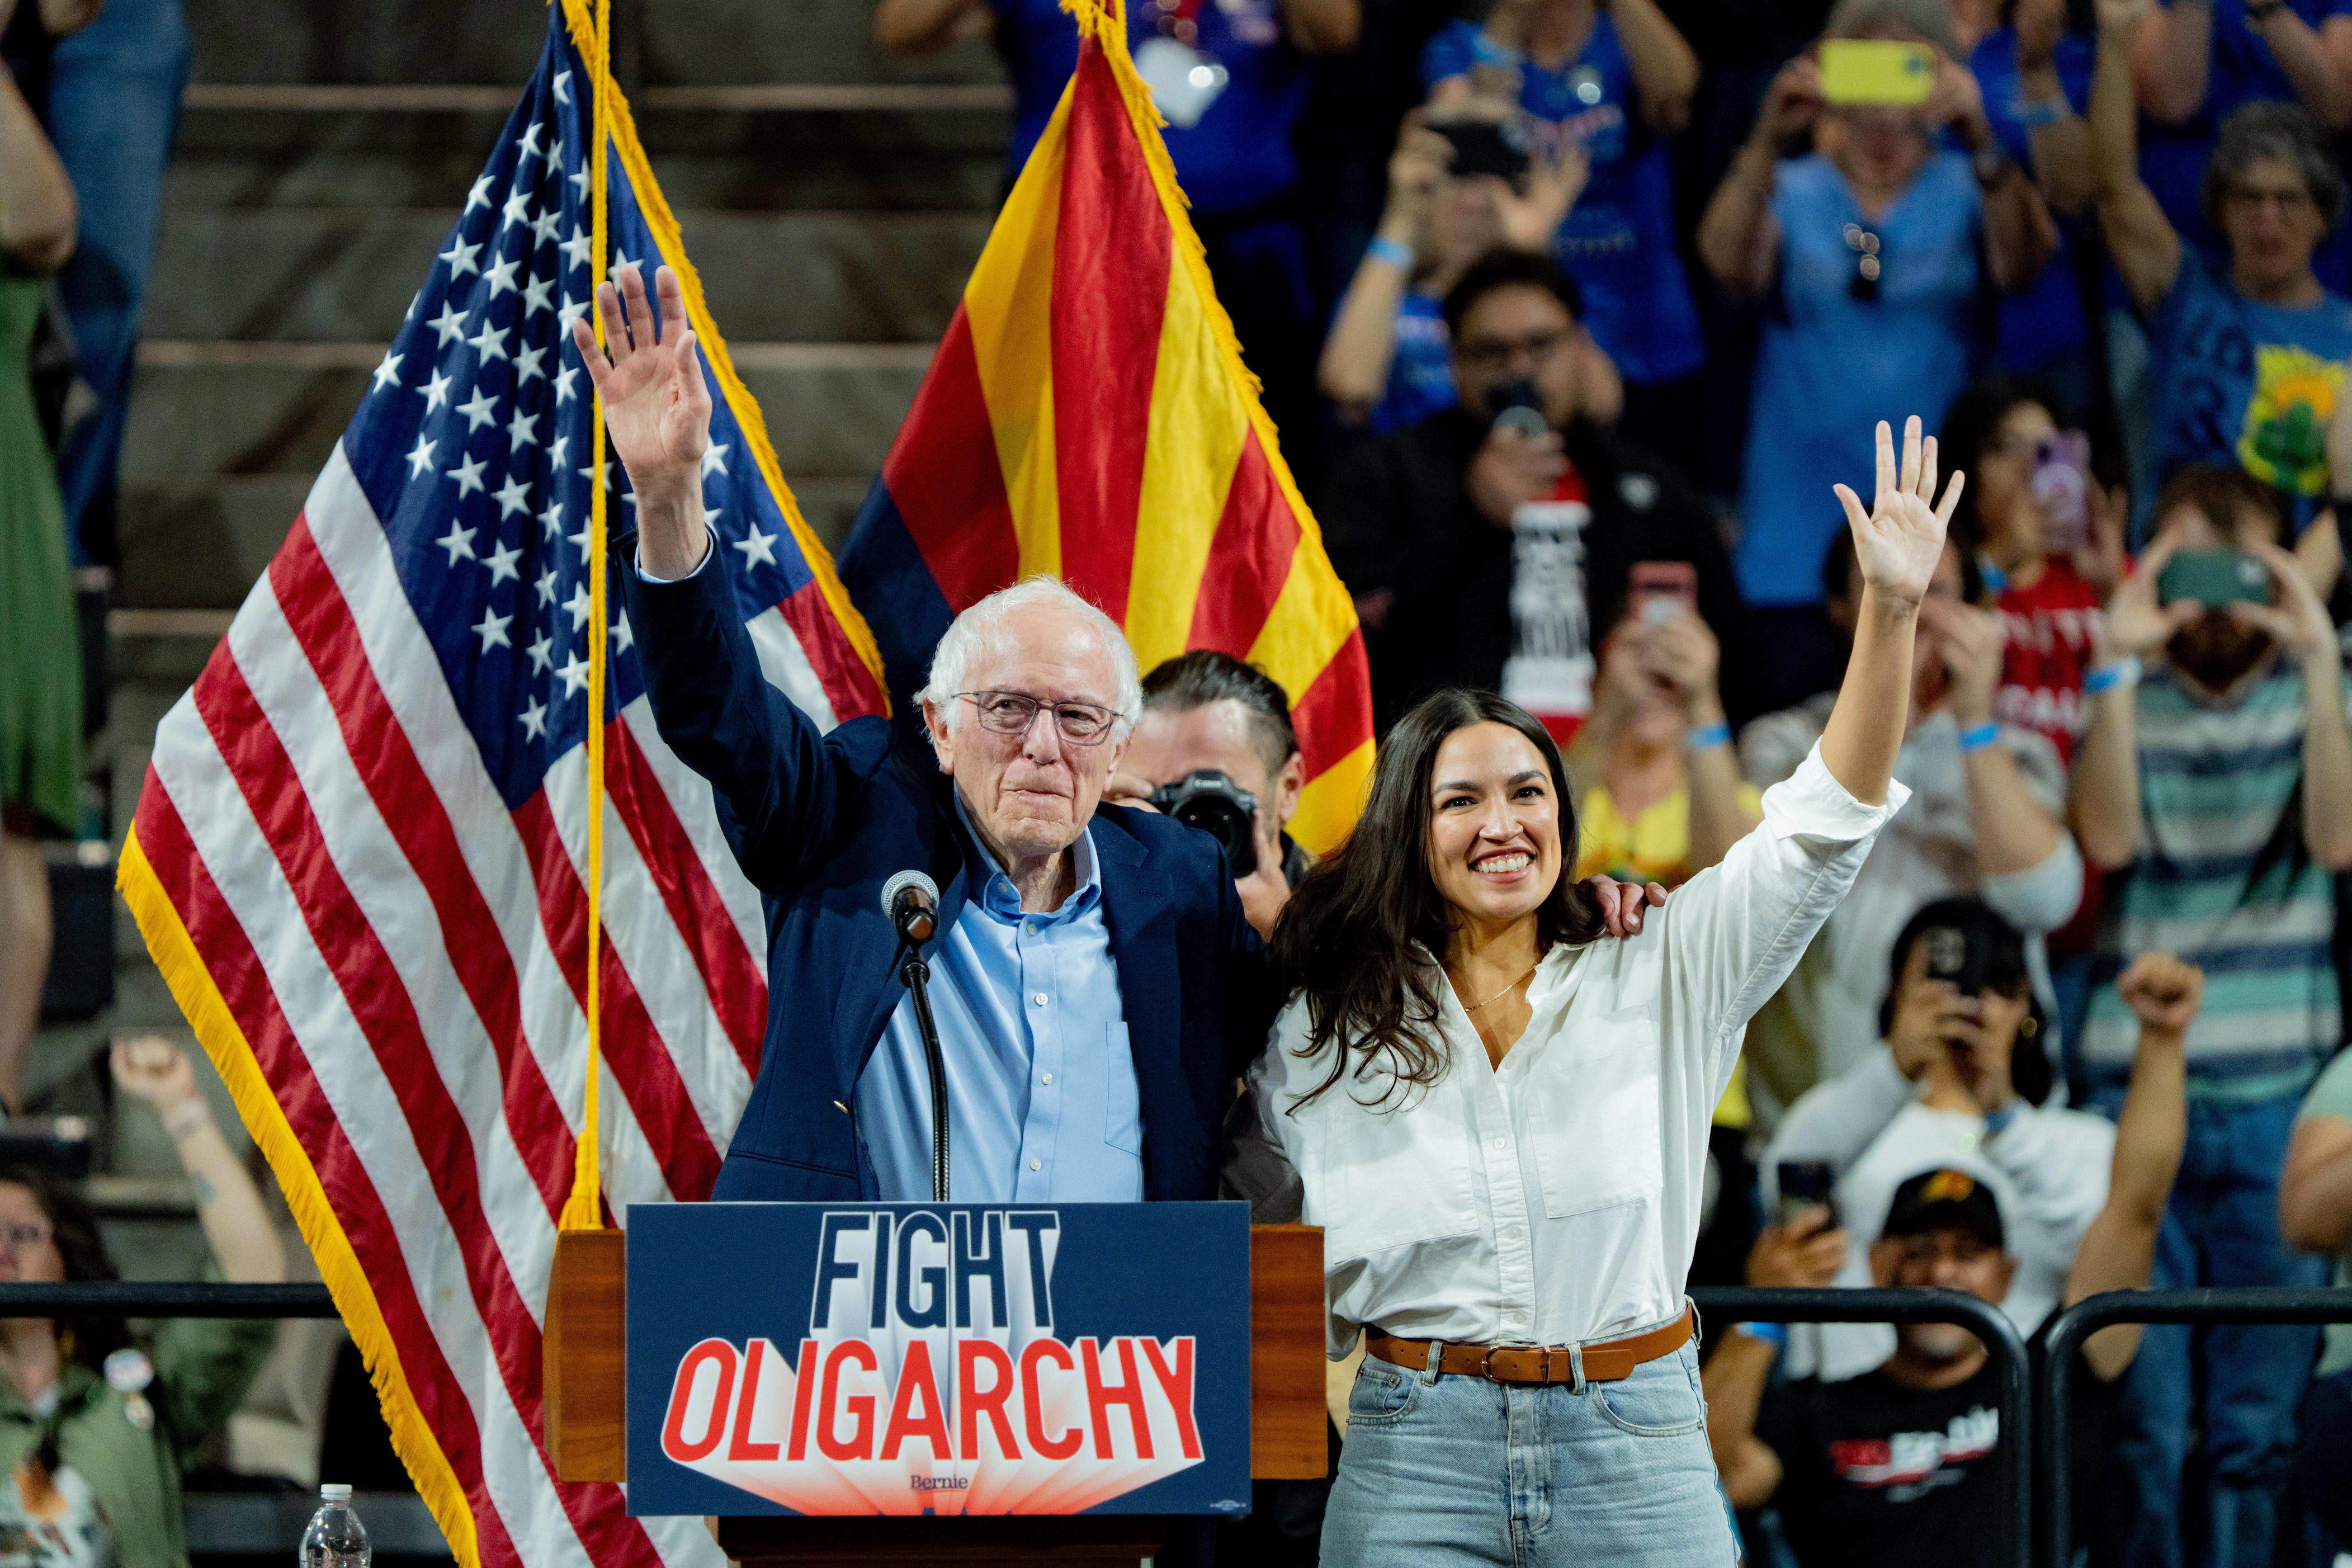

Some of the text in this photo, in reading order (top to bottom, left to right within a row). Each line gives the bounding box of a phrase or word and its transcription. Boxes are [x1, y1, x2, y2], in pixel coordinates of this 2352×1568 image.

[810, 1211, 1060, 1329] FIGHT
[662, 1337, 1203, 1461] OLIGARCHY
[910, 1474, 968, 1489] Bernie
